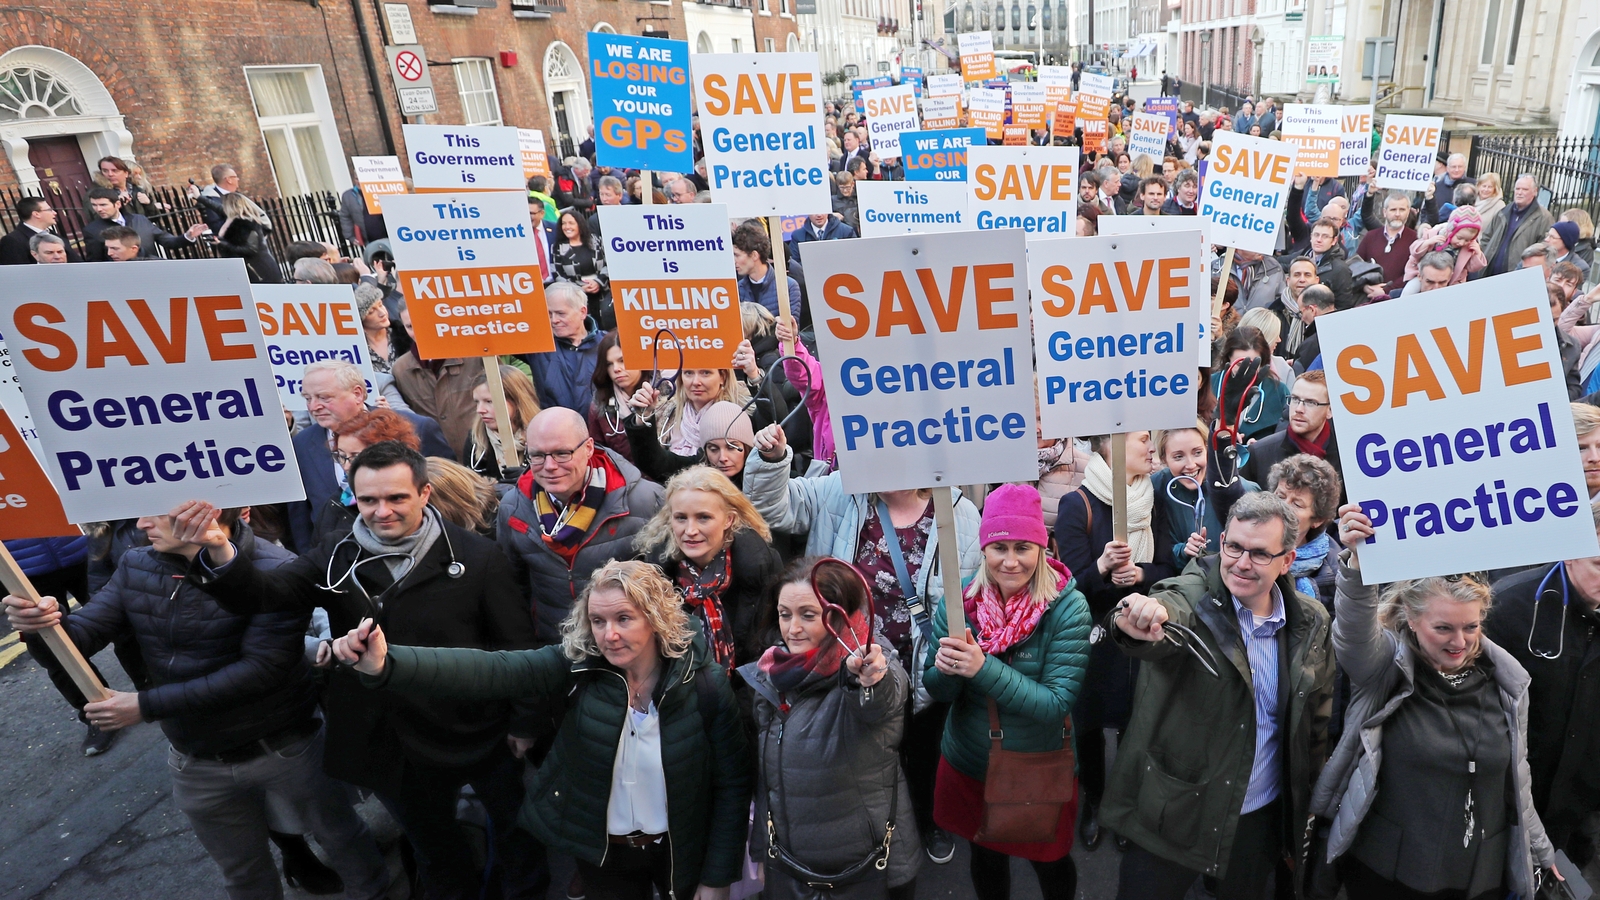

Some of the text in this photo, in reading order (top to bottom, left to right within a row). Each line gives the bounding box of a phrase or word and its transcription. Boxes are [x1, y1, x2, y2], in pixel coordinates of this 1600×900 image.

[606, 43, 672, 62] WE ARE
[962, 54, 992, 64] KILLING
[594, 60, 686, 85] LOSING
[626, 84, 656, 97] OUR
[702, 72, 816, 116] SAVE
[612, 98, 672, 116] YOUNG
[867, 94, 914, 117] SAVE
[1058, 104, 1076, 113] SORRY
[1080, 94, 1108, 106] KILLING
[1083, 103, 1103, 111] General
[971, 111, 1001, 120] KILLING
[1081, 108, 1103, 116] Practice
[1286, 116, 1338, 125] Government
[872, 117, 915, 133] General
[927, 119, 956, 128] KILLING
[1086, 121, 1106, 132] WE
[1134, 118, 1167, 134] SAVE
[444, 134, 480, 148] This
[601, 116, 687, 153] GPs
[712, 125, 815, 153] General
[1133, 133, 1163, 145] General
[1385, 125, 1438, 147] SAVE
[872, 138, 900, 150] Prac
[916, 137, 971, 151] WE ARE
[1130, 144, 1162, 156] Practice
[1340, 138, 1367, 149] neral
[415, 152, 515, 166] Government
[522, 152, 545, 161] LLING
[906, 151, 967, 170] LOSIN
[1214, 145, 1290, 185] SAVE
[1296, 160, 1329, 169] ractice
[1340, 155, 1368, 166] ctice
[1383, 149, 1432, 164] General
[462, 170, 475, 182] is
[713, 162, 823, 189] Practice
[935, 171, 961, 180] OUR
[975, 164, 1072, 201] SAVE
[1378, 166, 1430, 182] Practice
[364, 183, 404, 193] KILLING
[1209, 180, 1279, 209] General
[894, 191, 929, 205] This
[433, 203, 481, 220] This
[865, 209, 962, 224] Government
[1202, 204, 1275, 234] Practice
[643, 214, 685, 230] This
[977, 210, 1066, 232] General
[398, 223, 525, 243] Government
[611, 236, 724, 252] Government
[458, 246, 476, 261] is
[663, 258, 679, 273] is
[411, 272, 534, 300] KILLING
[1041, 256, 1191, 318] SAVE
[621, 287, 730, 311] KILLING
[822, 263, 1018, 341] SAVE
[434, 299, 522, 318] General
[256, 302, 358, 336] SAVE
[640, 315, 718, 330] General
[12, 294, 257, 372] SAVE
[435, 320, 529, 337] Practice
[640, 335, 724, 352] Practice
[1048, 322, 1184, 362] General
[267, 345, 362, 365] General
[1335, 306, 1552, 416] SAVE
[840, 347, 1015, 396] General
[1046, 369, 1190, 405] Practice
[47, 378, 264, 432] General
[842, 406, 1026, 451] Practice
[1355, 402, 1557, 478] General
[56, 440, 286, 491] Practice
[1358, 479, 1579, 545] Practice
